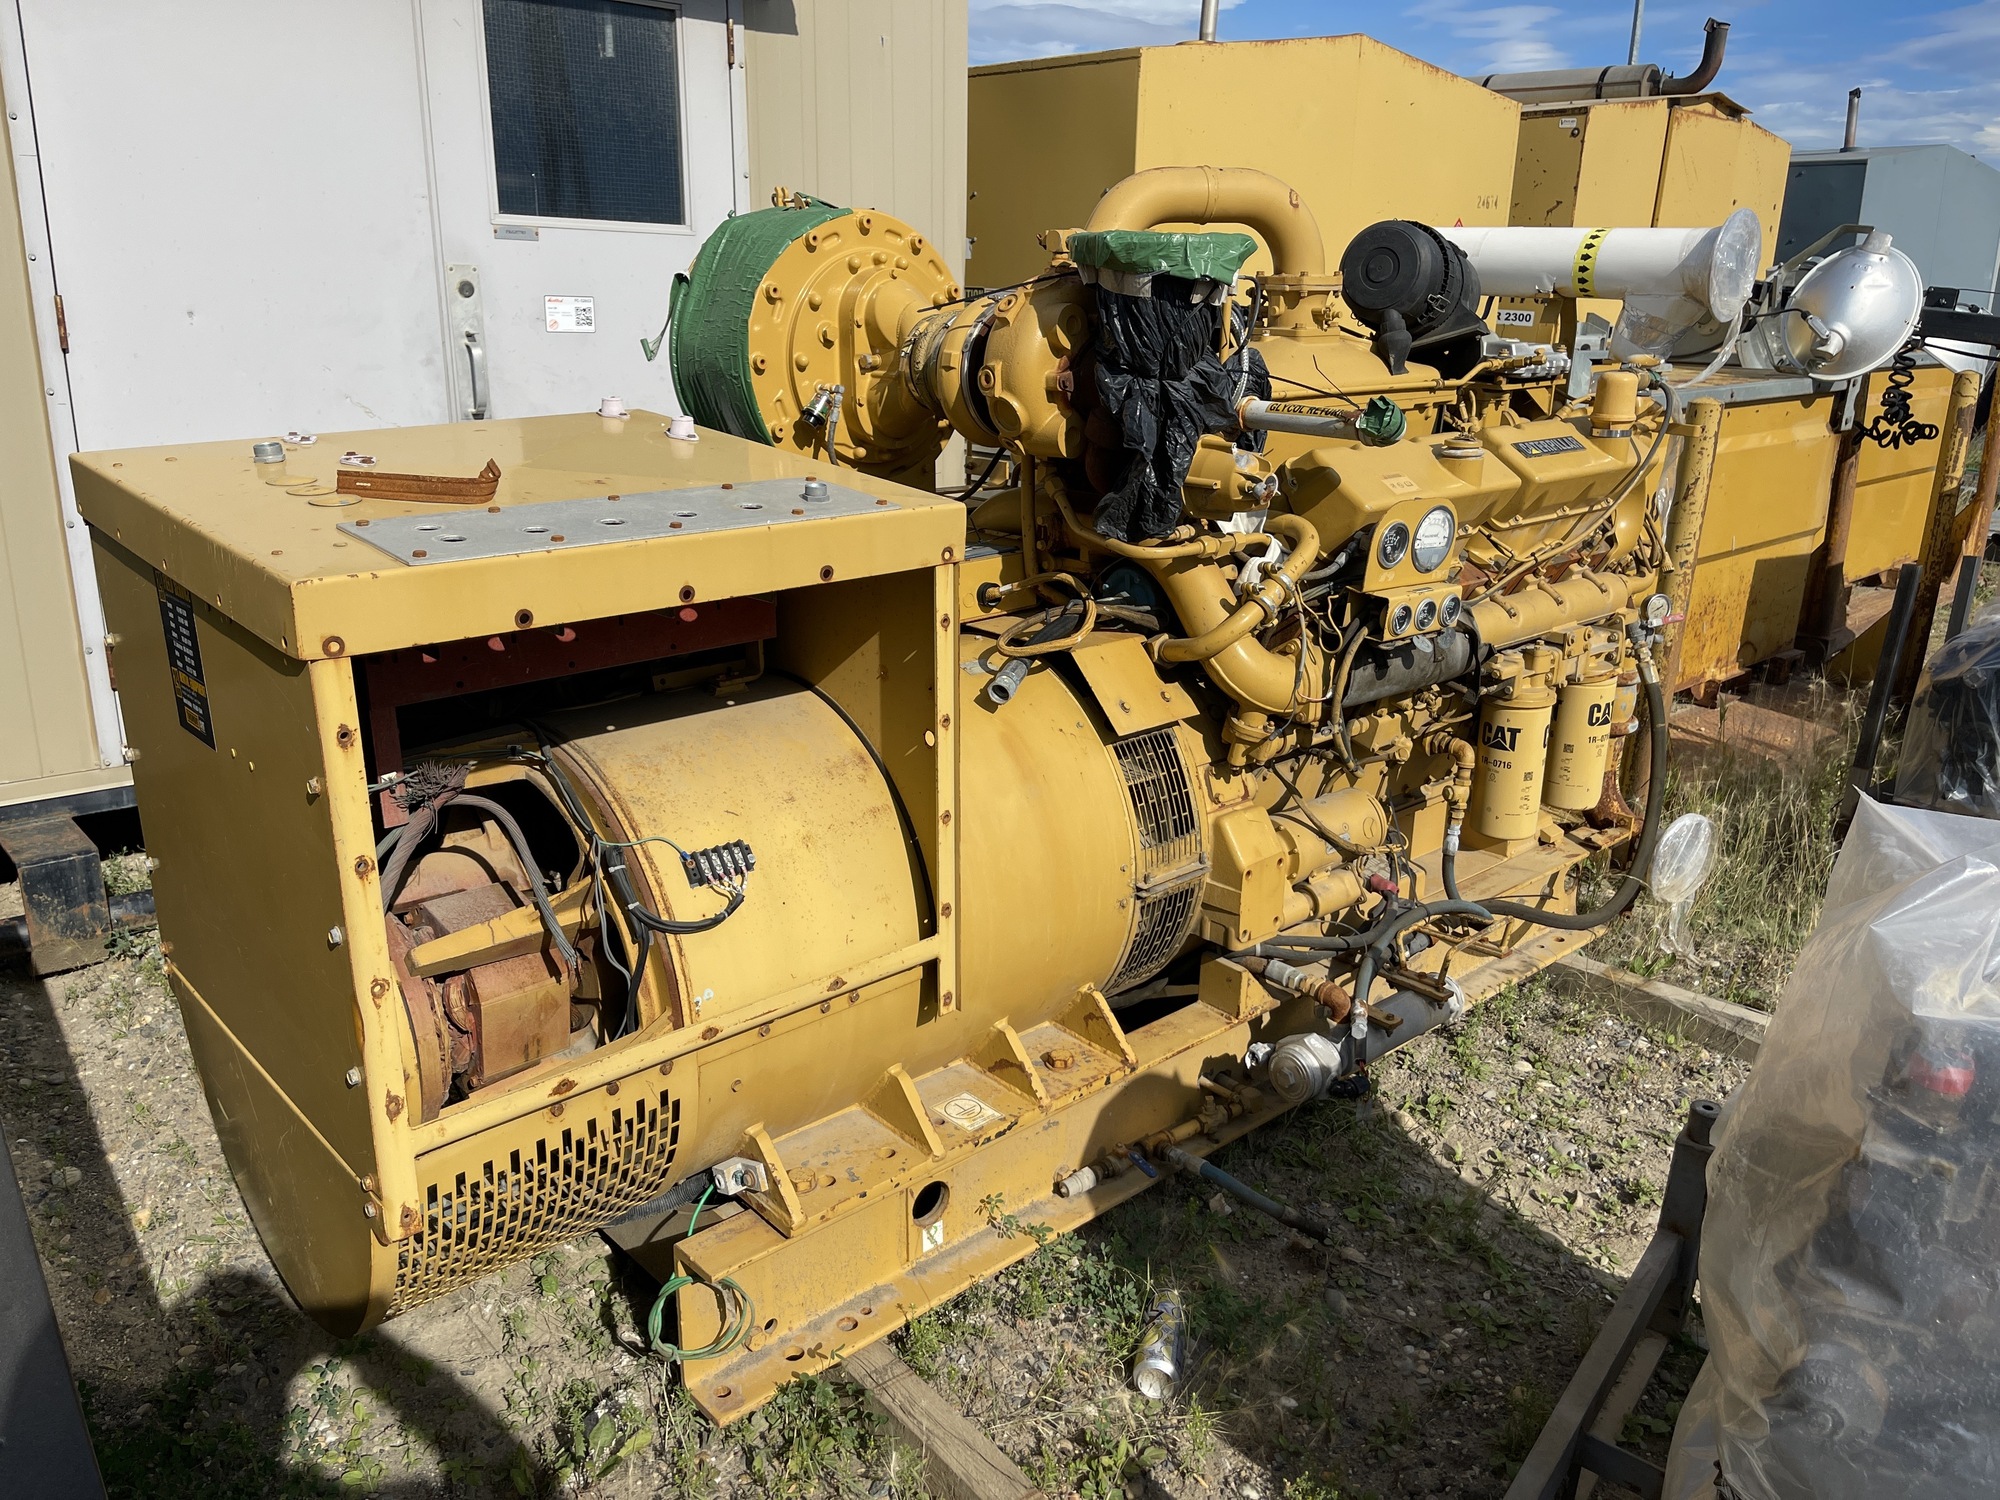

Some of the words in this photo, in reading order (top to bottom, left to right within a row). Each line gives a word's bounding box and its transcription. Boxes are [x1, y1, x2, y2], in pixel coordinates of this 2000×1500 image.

[1504, 312, 1532, 323] 2300
[1270, 402, 1305, 414] GLYCOL
[1519, 437, 1583, 455] CATERPILLAR
[1587, 700, 1615, 727] CA
[1482, 721, 1522, 752] CAT
[1481, 755, 1512, 770] 1R-0716
